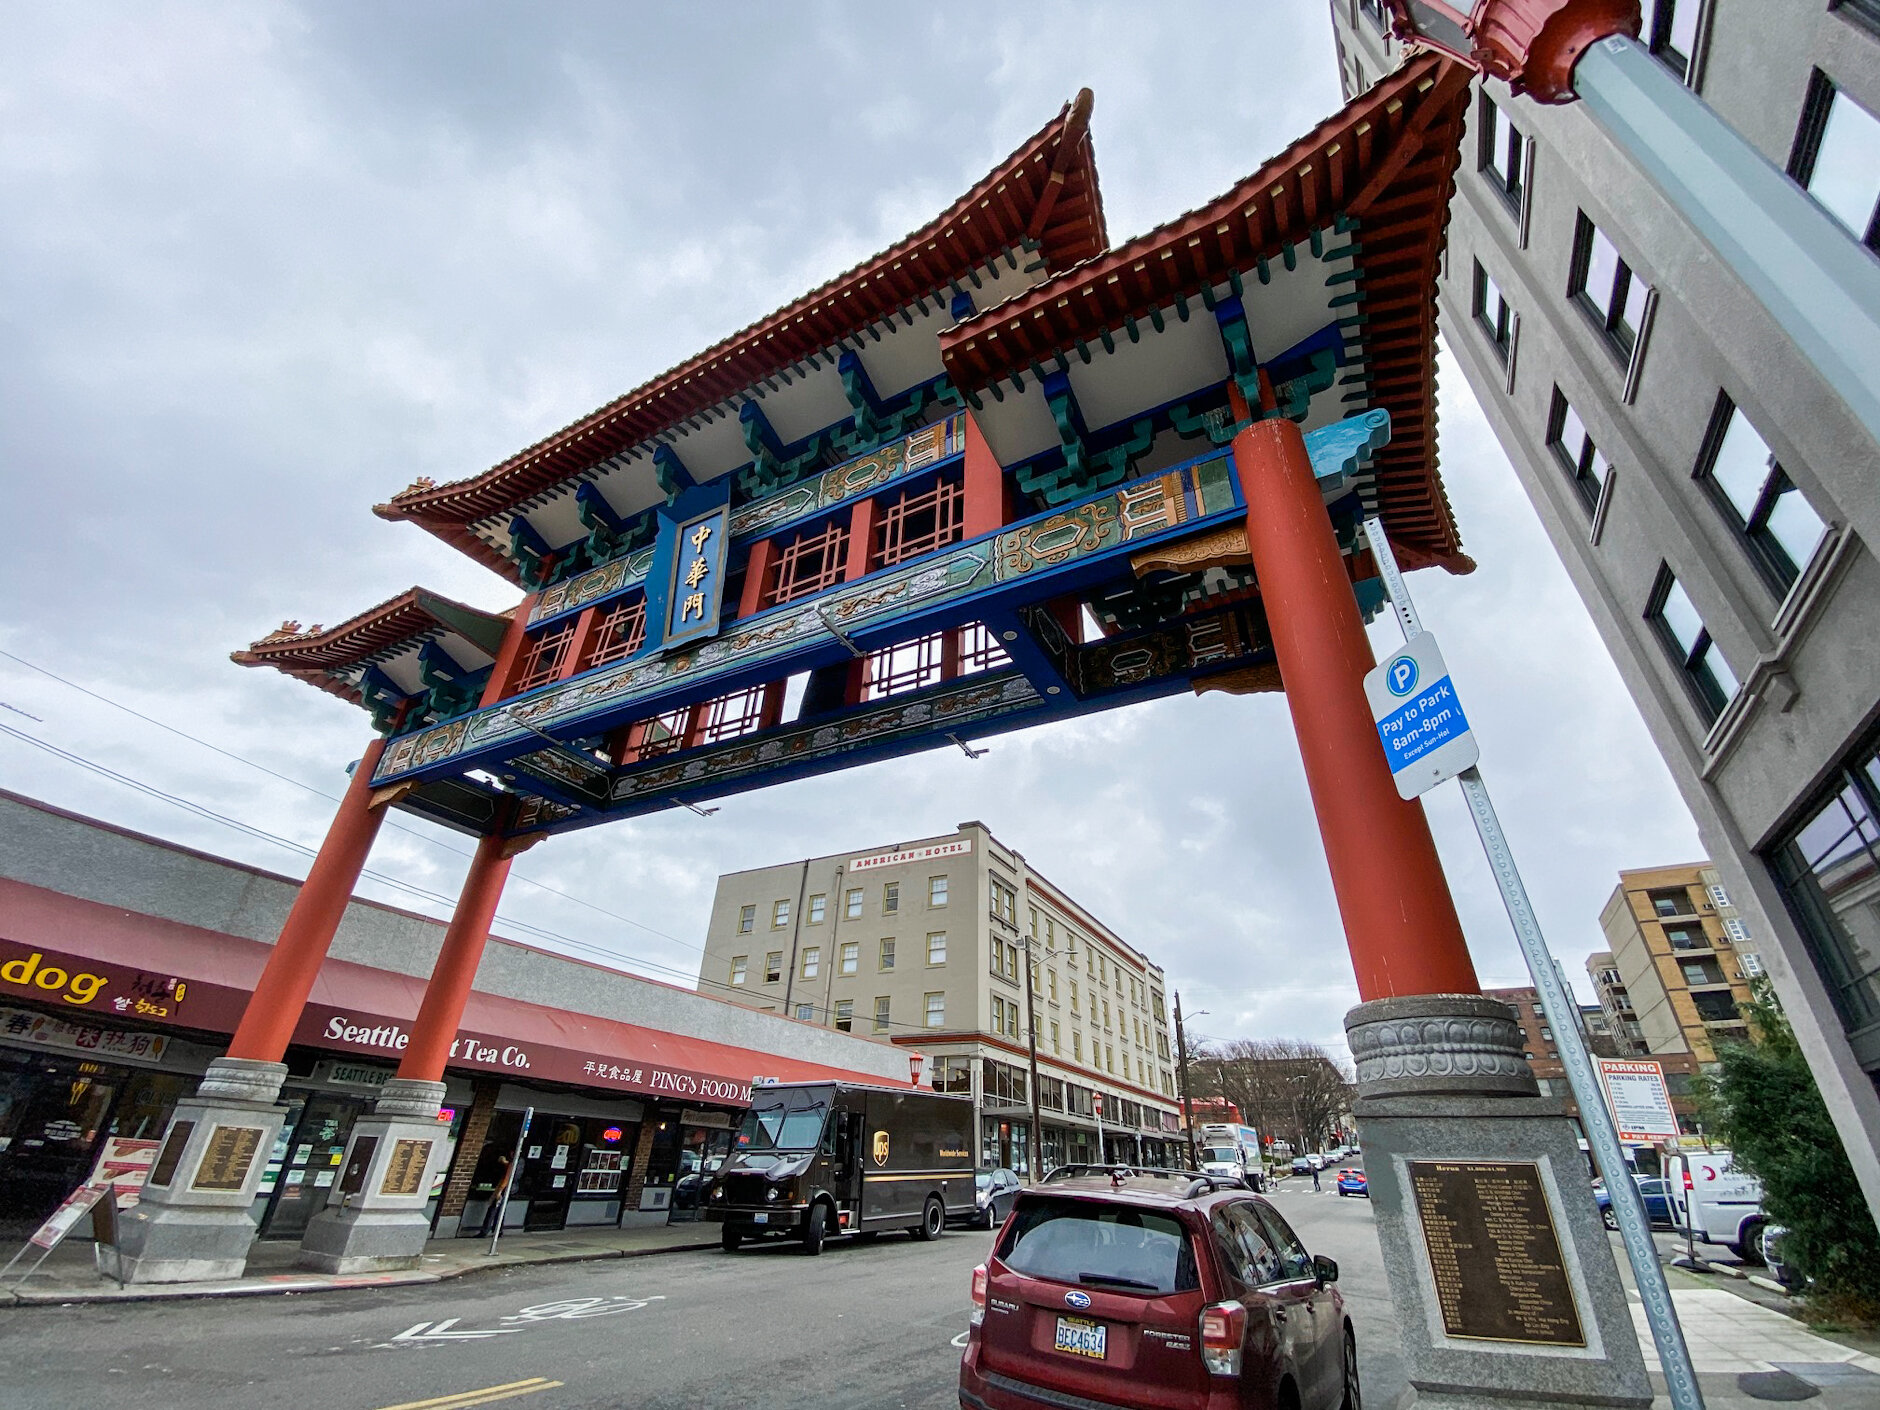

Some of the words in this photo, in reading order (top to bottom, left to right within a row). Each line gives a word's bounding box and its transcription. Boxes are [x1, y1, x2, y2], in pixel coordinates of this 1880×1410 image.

[681, 525, 712, 623] 中華門
[1393, 664, 1411, 690] P
[1382, 716, 1404, 737] Pay
[1404, 708, 1418, 722] to
[1418, 685, 1451, 713] Park
[1392, 707, 1452, 751] 8am-8pm
[1404, 743, 1424, 760] Except
[1423, 728, 1450, 750] Sun-Hol
[856, 851, 915, 868] AMERICAN
[925, 844, 963, 856] HOTEL
[324, 1016, 410, 1050] Seattle
[462, 1039, 497, 1064] Tea
[501, 1045, 531, 1069] Co.
[332, 1066, 375, 1084] SEATTLE
[375, 1071, 395, 1085] BE
[1603, 1063, 1657, 1072] PARKING
[699, 1079, 739, 1100] FOOD
[875, 1141, 888, 1161] ups
[990, 1298, 1020, 1311] SUBARU
[1067, 1316, 1096, 1327] SEATTLE
[1057, 1326, 1104, 1353] BEC4634
[1143, 1329, 1191, 1341] FORESTER
[1055, 1343, 1105, 1360] CARTER
